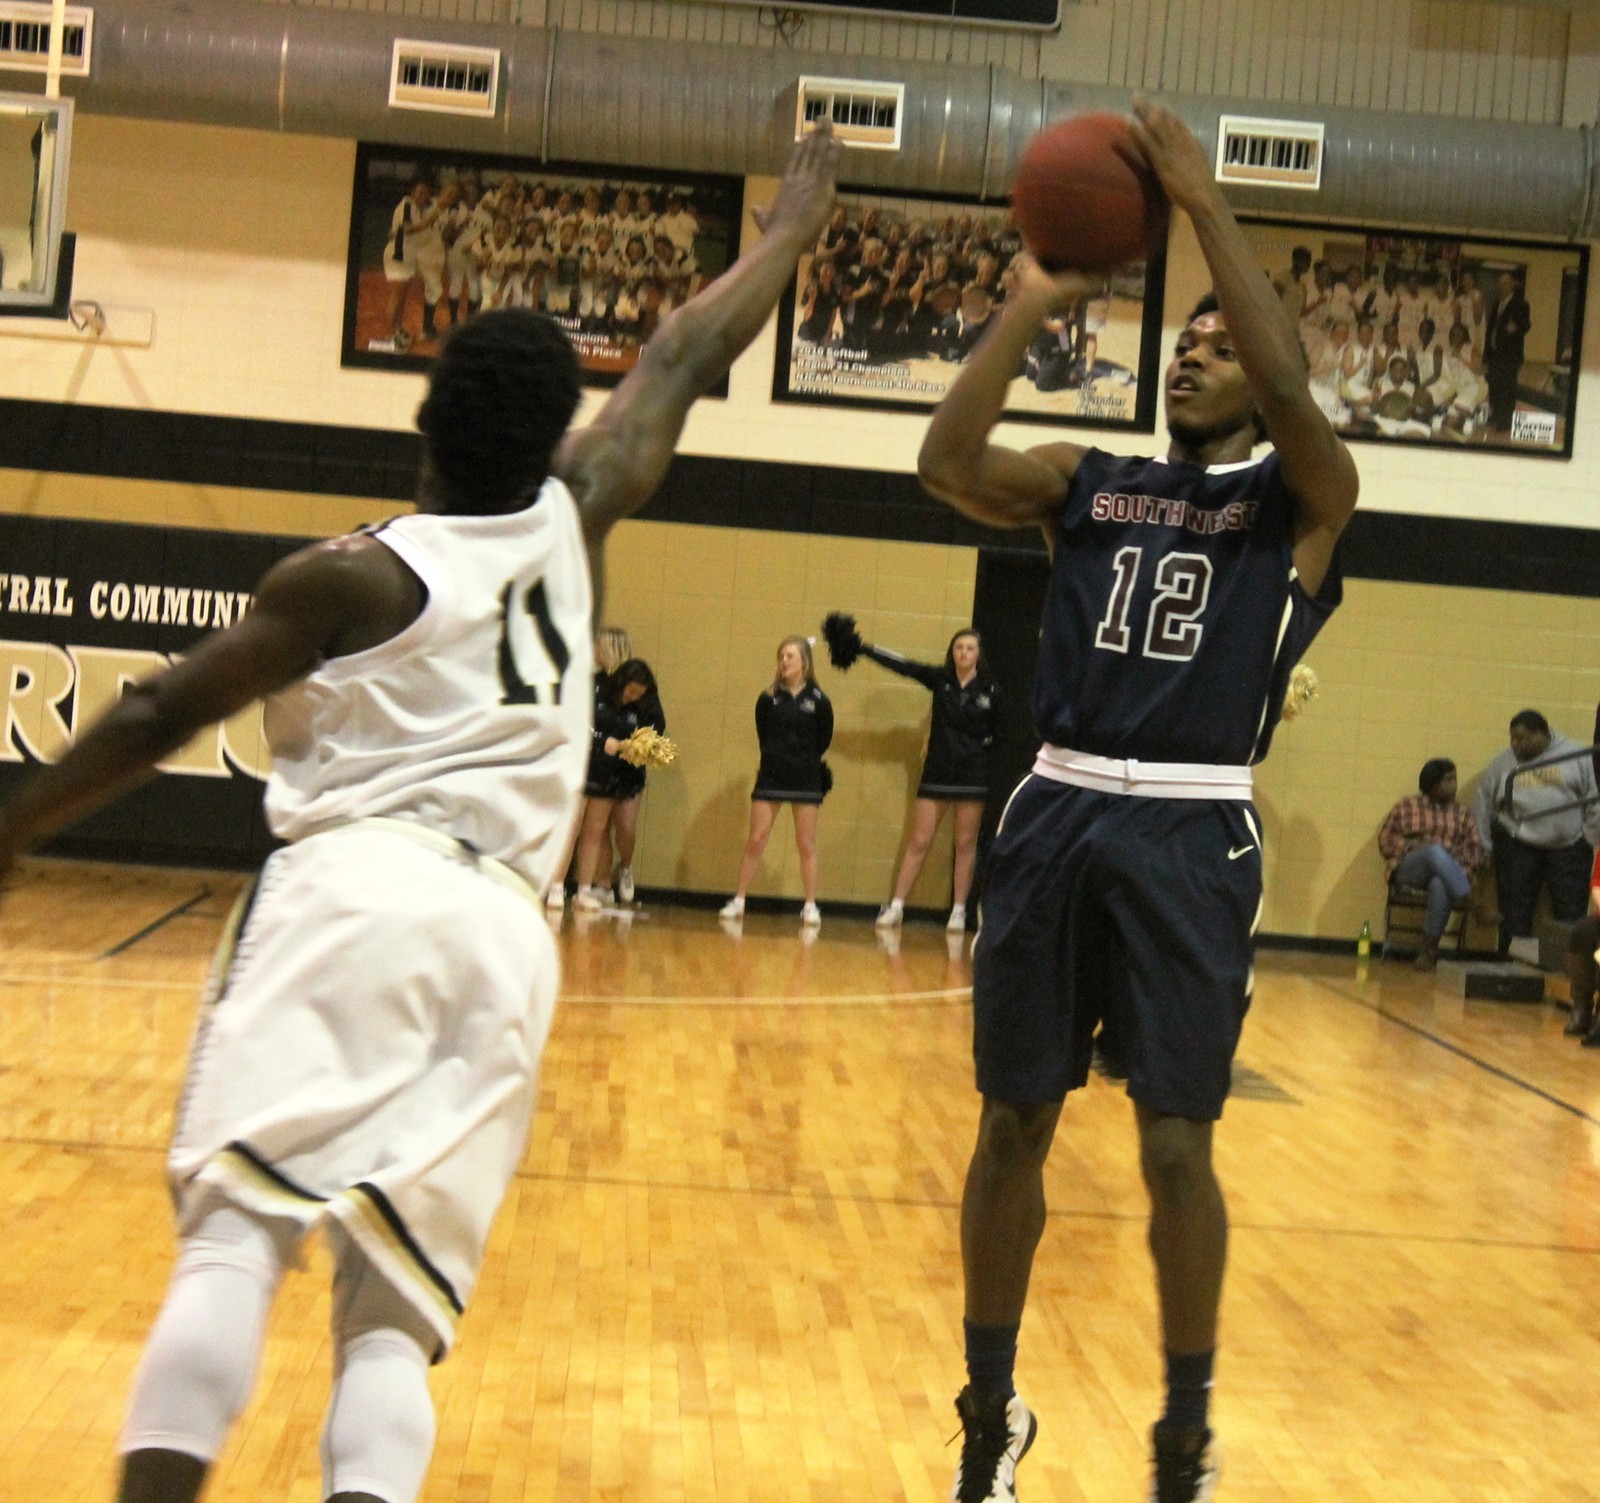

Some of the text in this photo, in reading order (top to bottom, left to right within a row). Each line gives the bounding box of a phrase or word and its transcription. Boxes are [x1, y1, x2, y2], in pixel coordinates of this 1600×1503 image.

[826, 346, 868, 361] Softball
[852, 362, 910, 377] Champions
[1092, 492, 1259, 535] SOUTHWEST
[89, 580, 256, 630] COMMUNI
[1094, 545, 1214, 662] 12
